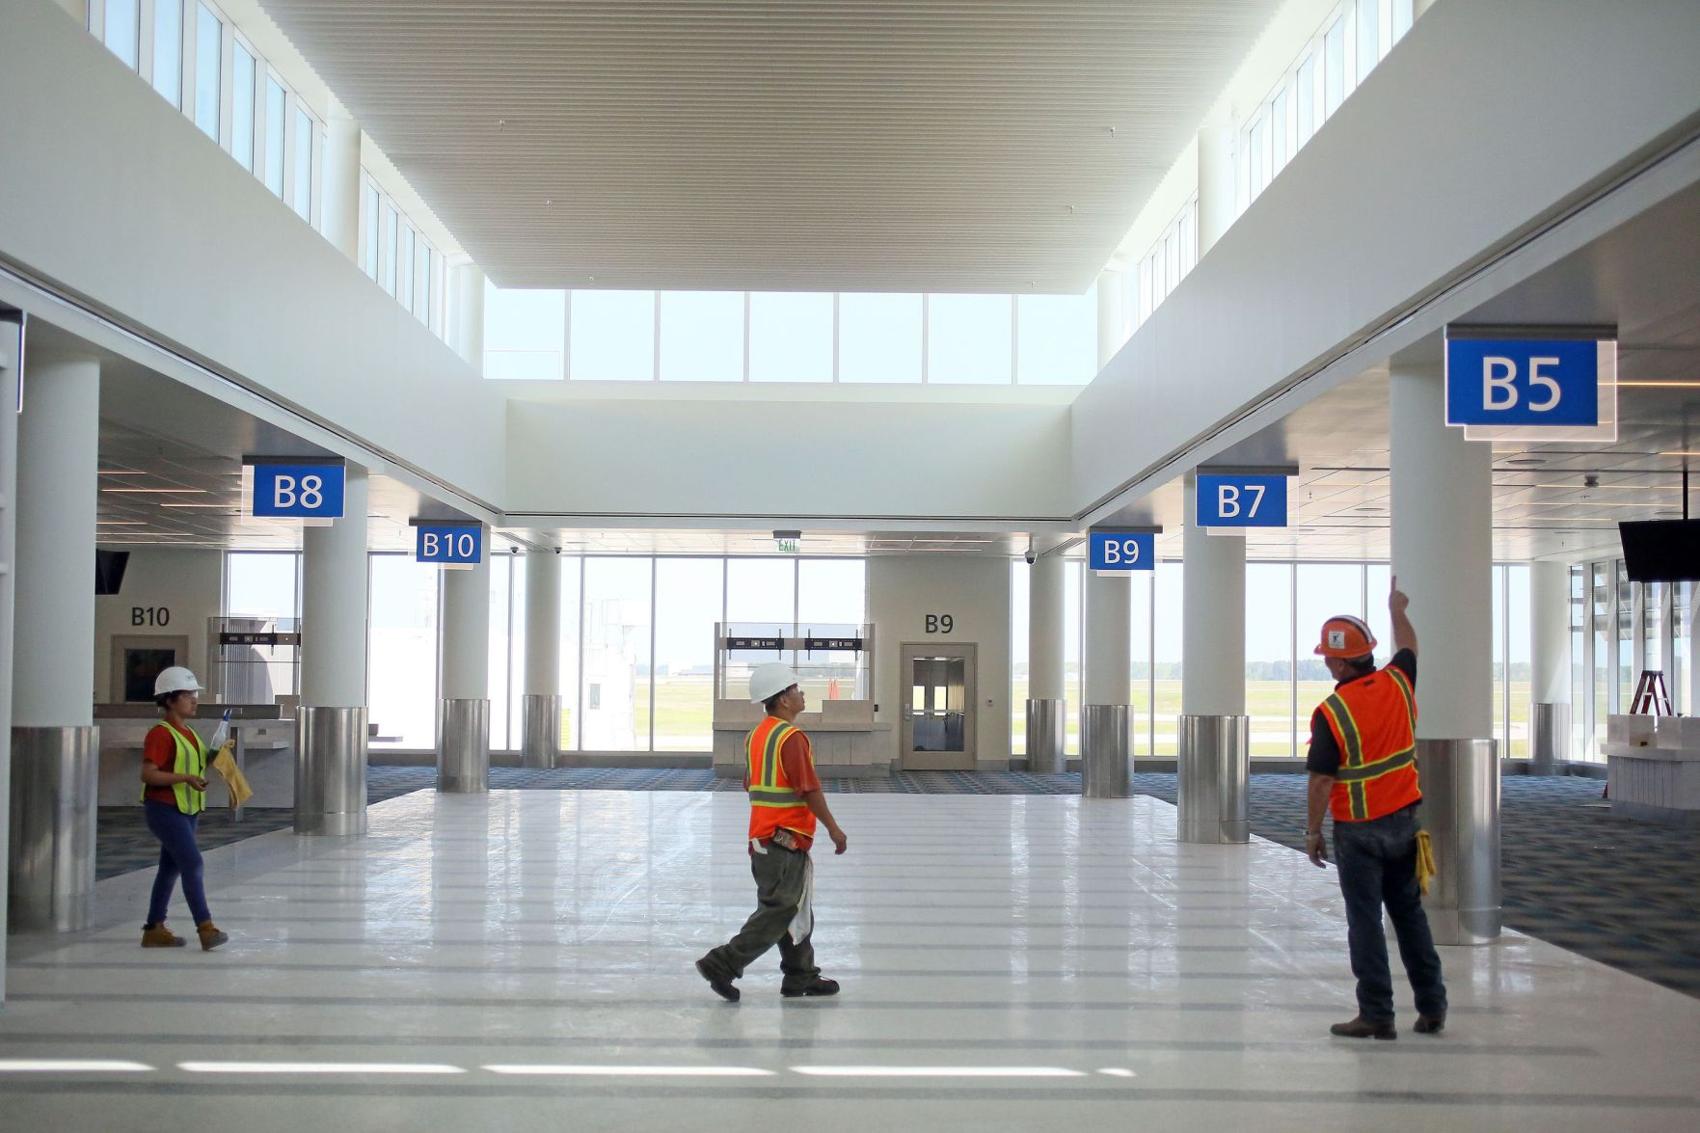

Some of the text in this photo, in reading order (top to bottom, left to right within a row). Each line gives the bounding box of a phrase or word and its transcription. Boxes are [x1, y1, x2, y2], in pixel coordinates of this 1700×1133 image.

[1482, 356, 1561, 412] B5
[274, 475, 323, 509] B8
[1218, 485, 1266, 518] B7
[423, 533, 474, 558] B10
[1104, 539, 1139, 564] B9
[131, 606, 170, 627] B10
[925, 614, 954, 634] B9
